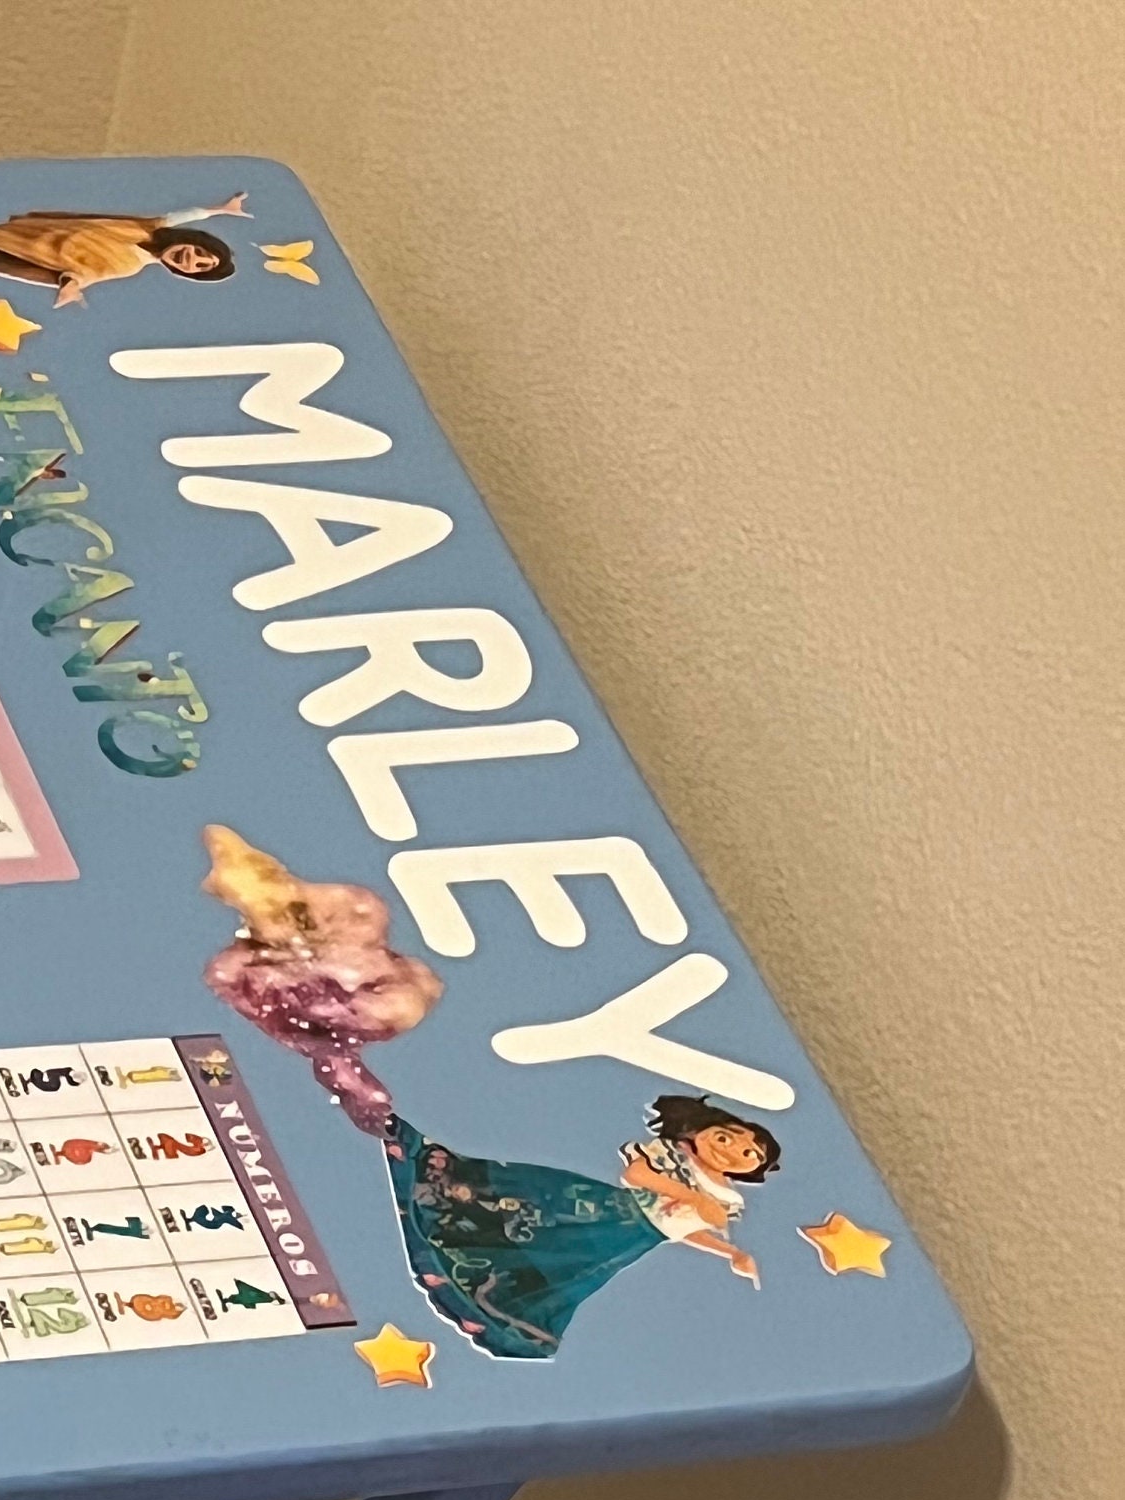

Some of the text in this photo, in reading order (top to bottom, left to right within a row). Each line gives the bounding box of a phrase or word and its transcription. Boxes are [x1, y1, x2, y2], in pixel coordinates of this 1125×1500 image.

[109, 342, 796, 1111] MARLEY
[16, 1066, 86, 1094] 5
[121, 1064, 183, 1085] 1
[46, 1136, 121, 1167] 6
[145, 1130, 211, 1160] 2
[211, 1099, 319, 1278] NÚMEROS
[80, 1215, 151, 1245] 7
[177, 1202, 246, 1235] 3
[112, 1290, 189, 1324] 8
[210, 1275, 285, 1312] 4
[8, 1284, 92, 1339] 12
